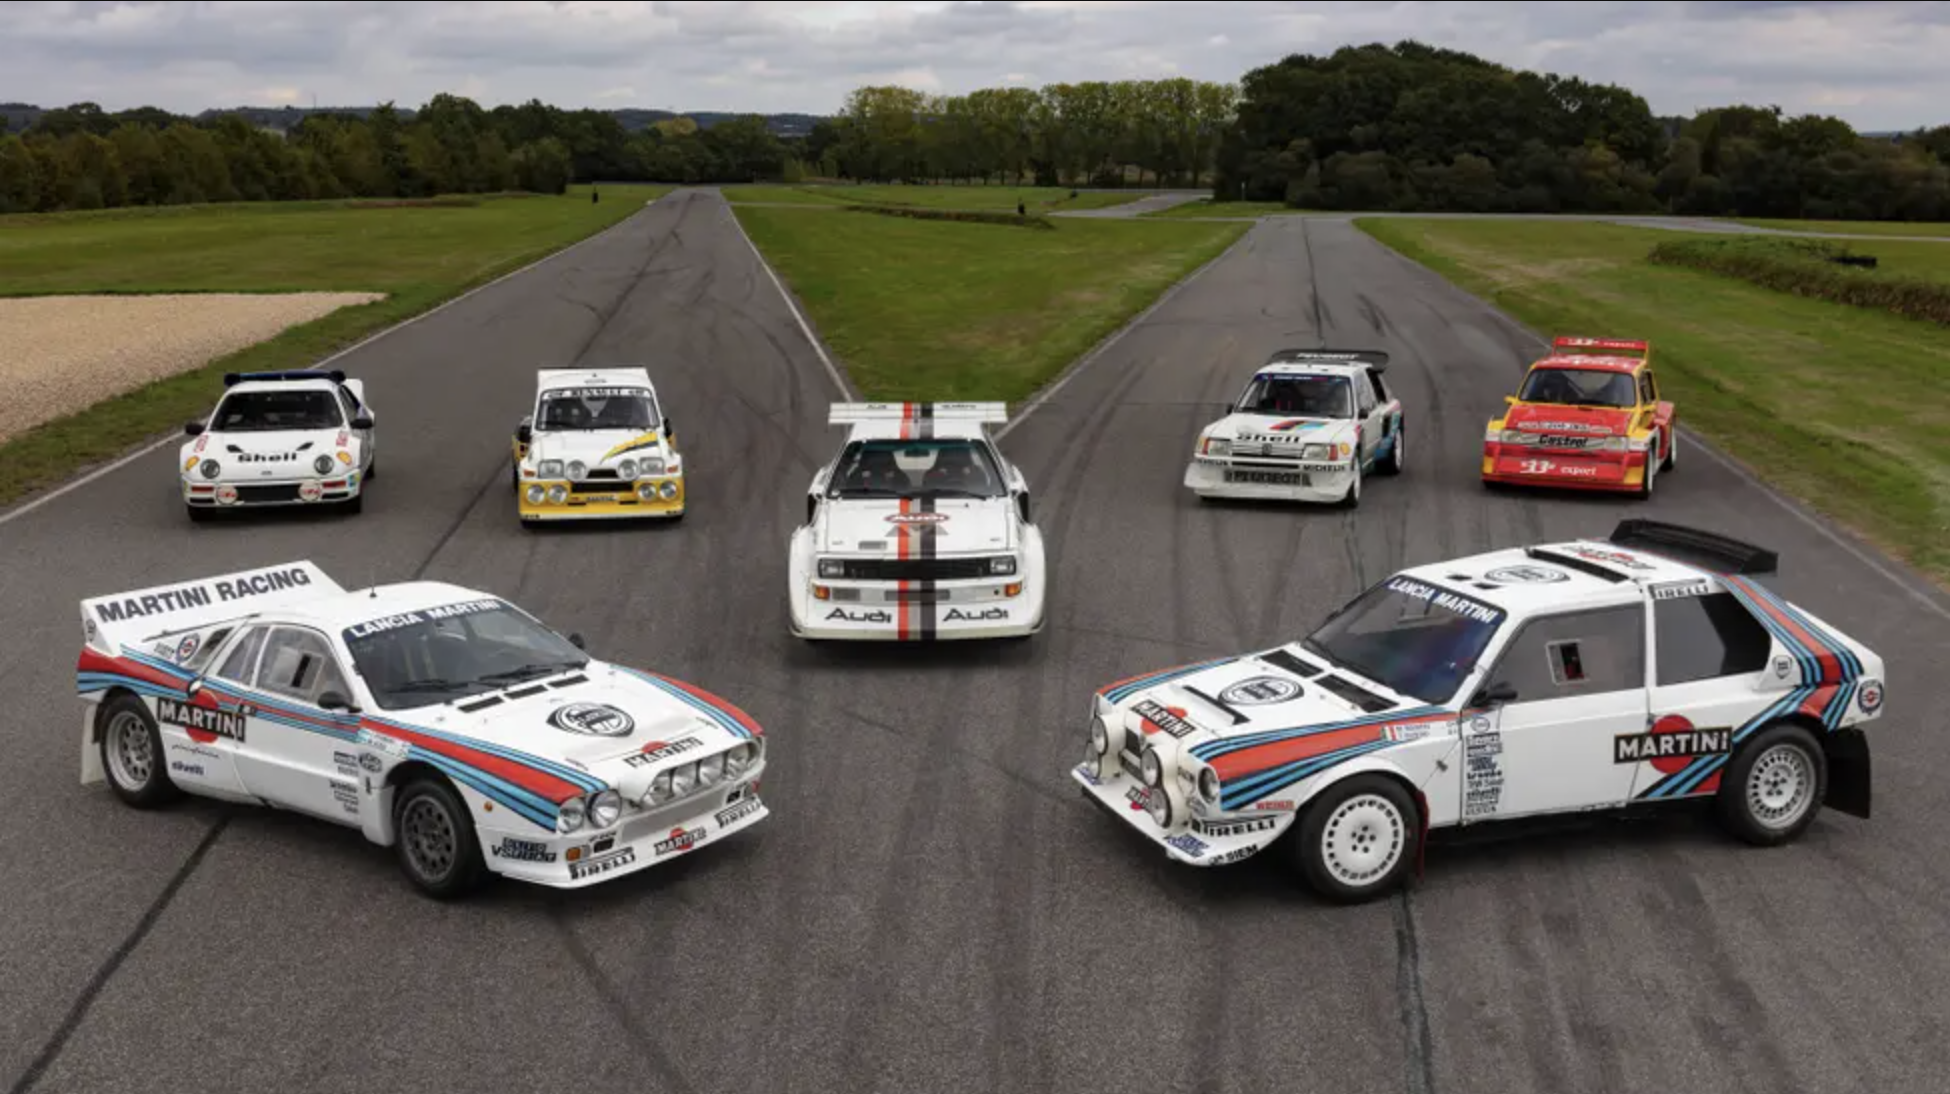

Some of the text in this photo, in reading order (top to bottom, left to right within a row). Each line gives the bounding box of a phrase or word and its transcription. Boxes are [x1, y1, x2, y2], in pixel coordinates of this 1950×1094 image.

[1539, 434, 1588, 448] Castrol
[237, 452, 297, 463] Shell
[1560, 466, 1597, 476] export
[95, 568, 311, 623] MARTINI RACING
[1388, 578, 1499, 624] LANCIA MARTINI
[350, 600, 501, 638] LANCIA MARTINI
[825, 607, 893, 623] Audi
[942, 607, 1009, 622] Audi
[159, 699, 244, 741] MARTINI
[1134, 700, 1192, 739] MARTINI
[626, 736, 702, 767] MARTINI
[1618, 732, 1729, 760] MARTINI
